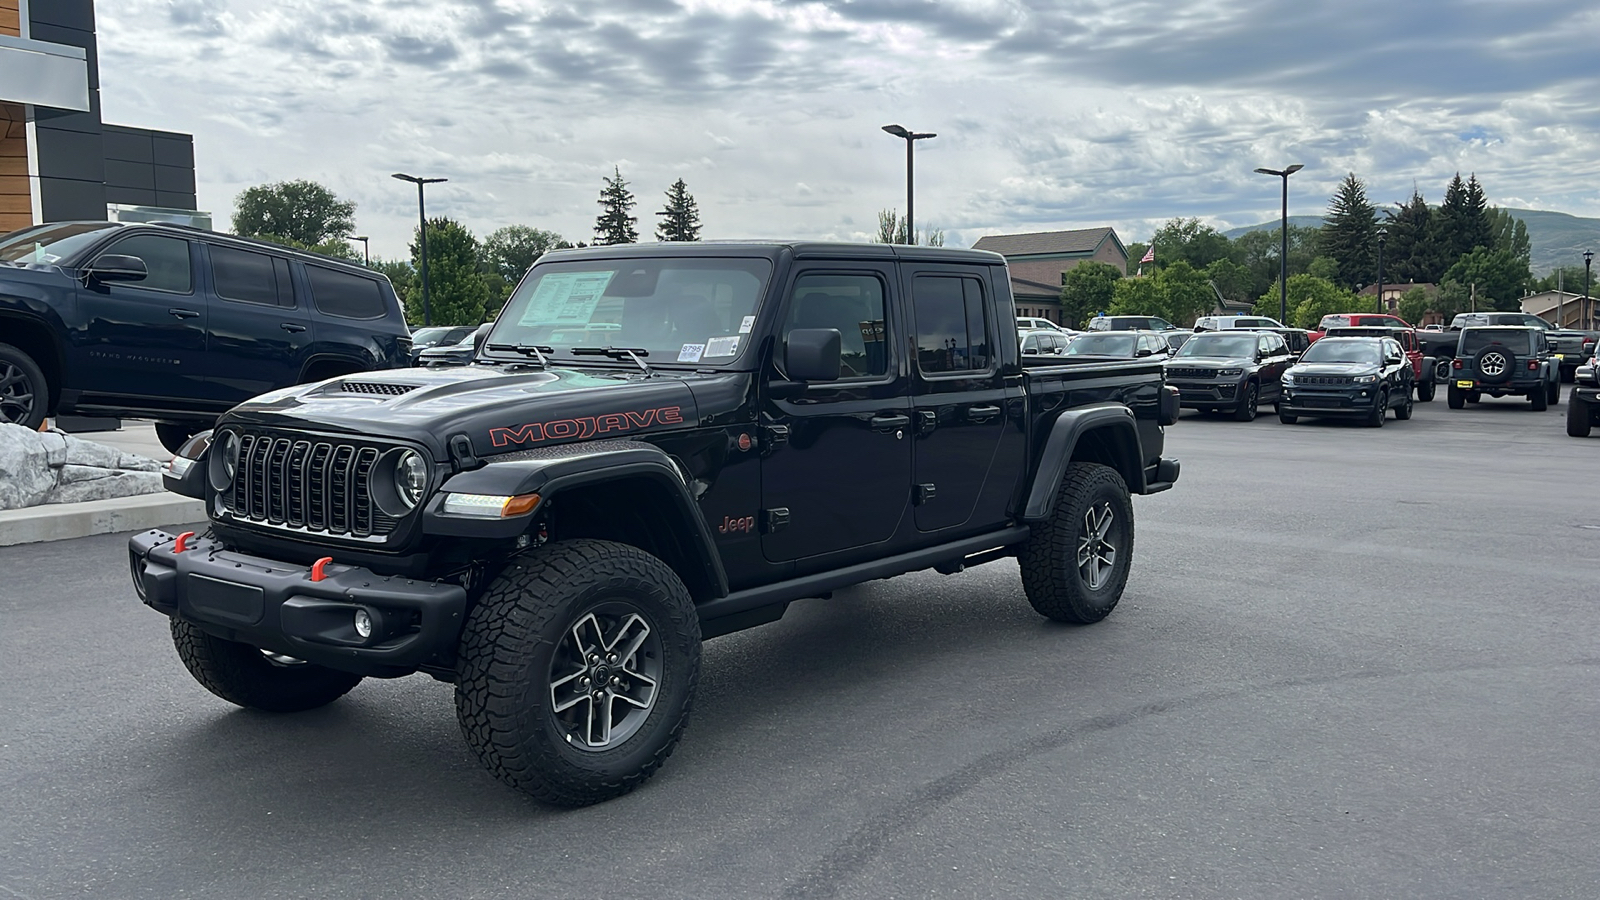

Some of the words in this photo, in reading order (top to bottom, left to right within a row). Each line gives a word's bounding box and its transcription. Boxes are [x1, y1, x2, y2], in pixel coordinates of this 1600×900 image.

[89, 351, 121, 359] GRAND
[489, 406, 683, 447] MOJAVE
[719, 515, 755, 533] Jeep
